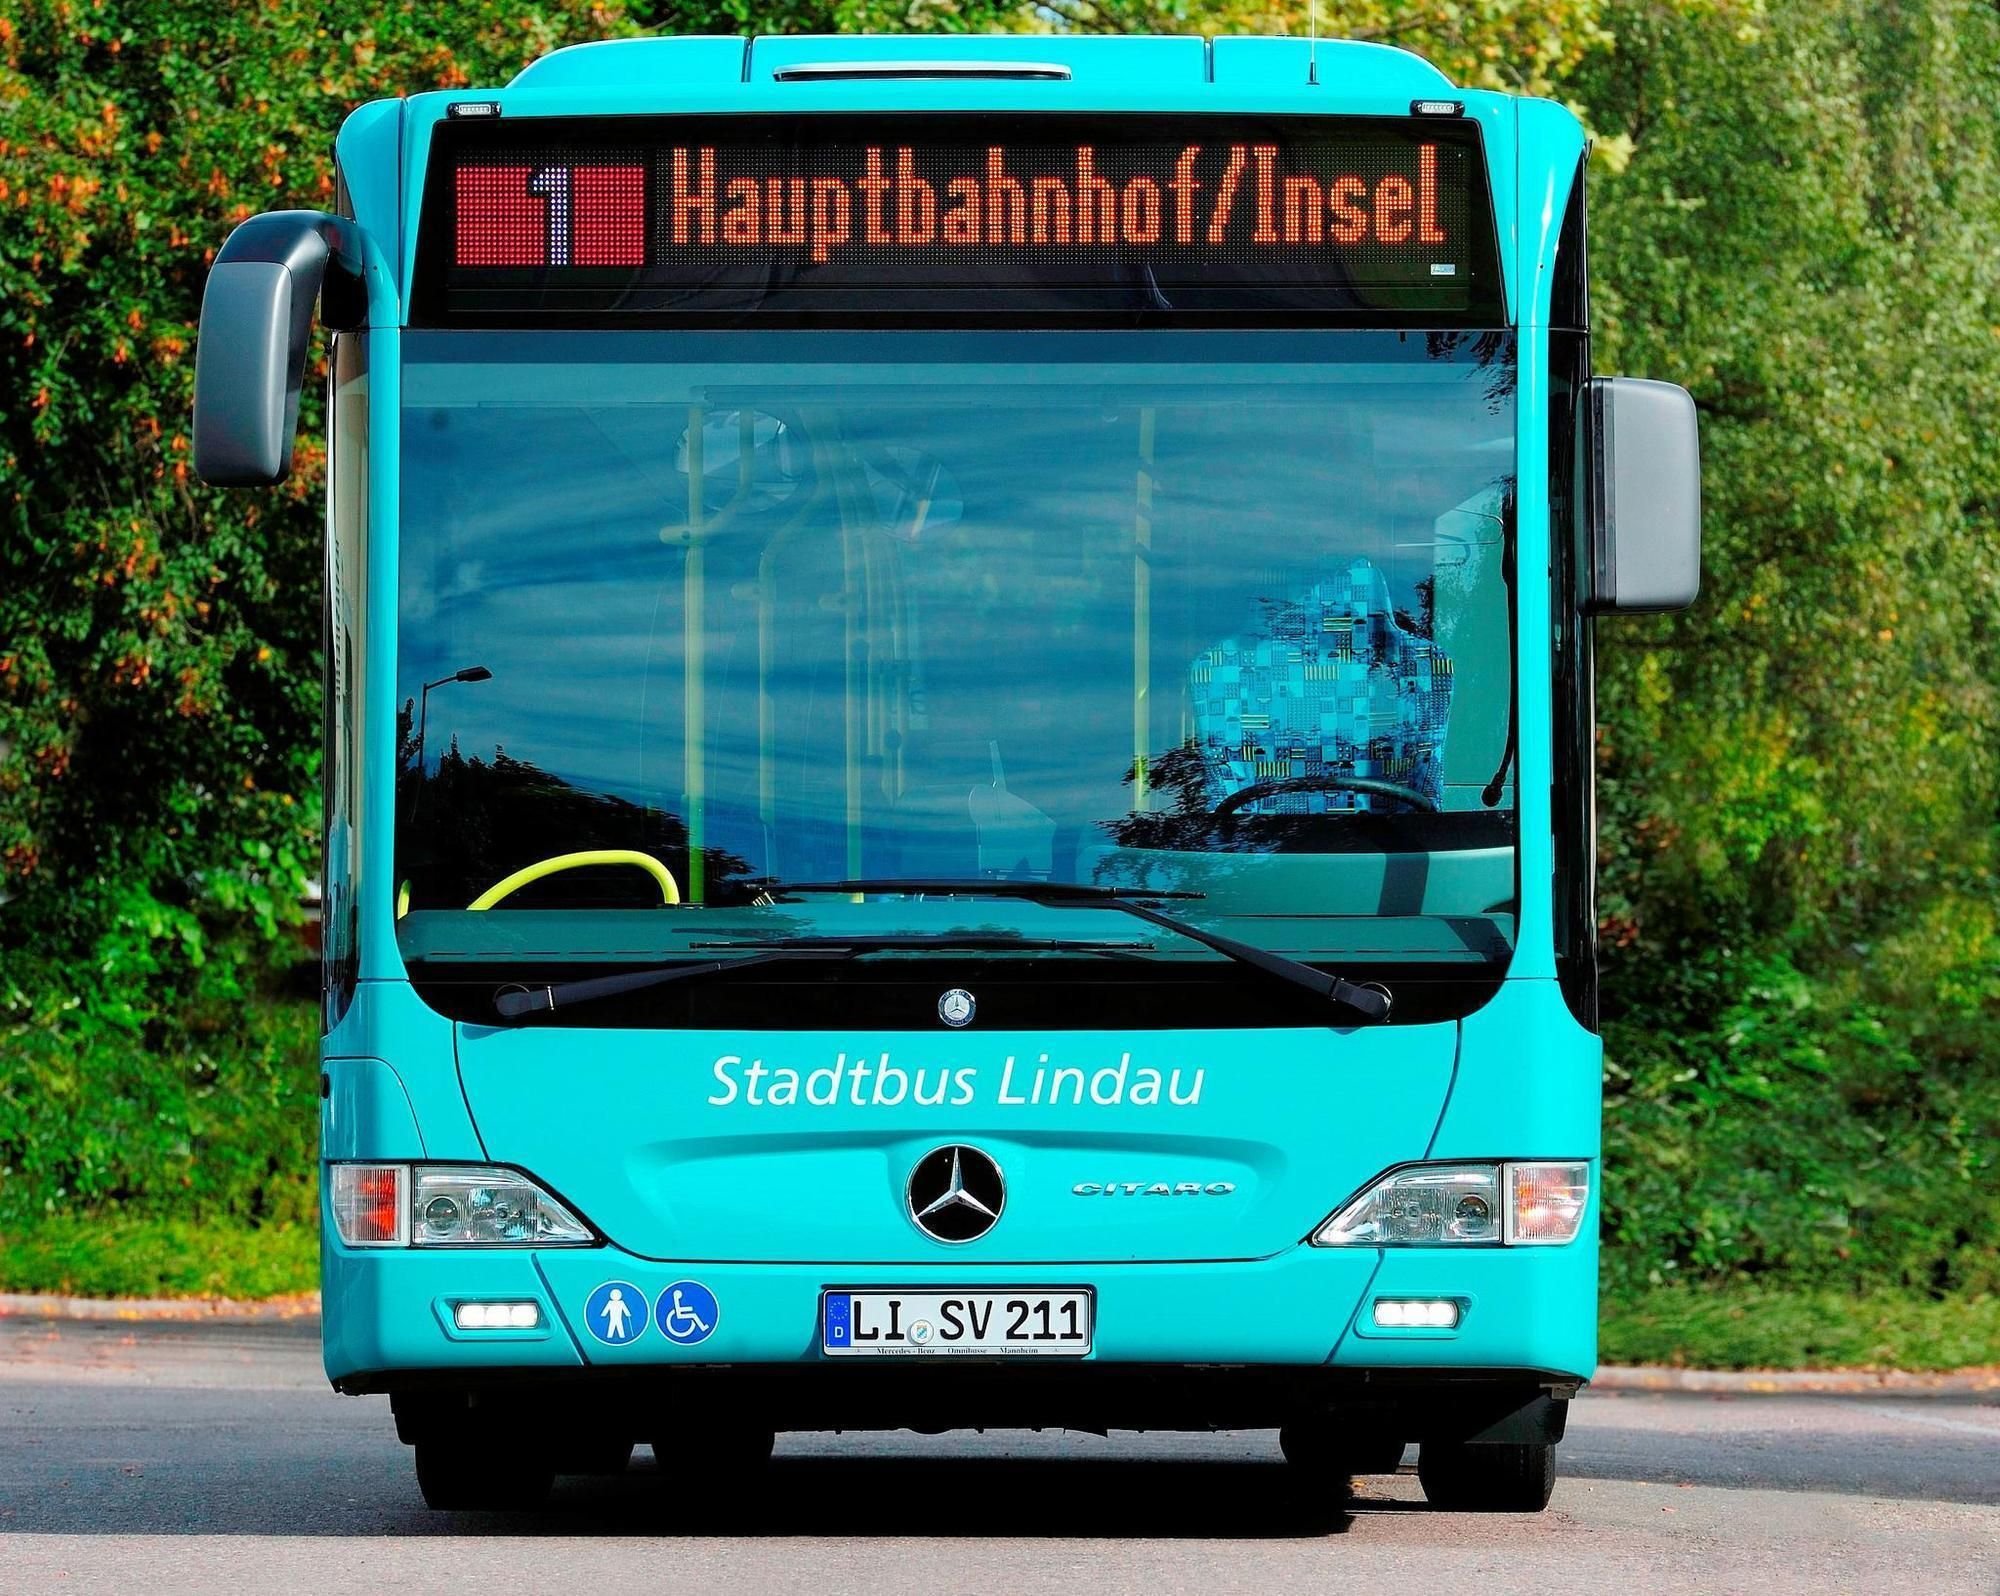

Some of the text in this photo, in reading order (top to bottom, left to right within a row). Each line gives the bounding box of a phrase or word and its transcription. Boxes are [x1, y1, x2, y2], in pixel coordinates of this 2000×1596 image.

[528, 143, 1447, 266] 1 Hauptbahnhof/Insel
[707, 1052, 1206, 1106] Stadtbus Lindau
[1072, 1182, 1237, 1196] CITARO
[834, 1326, 844, 1338] D
[853, 1300, 1083, 1340] LI SV 211
